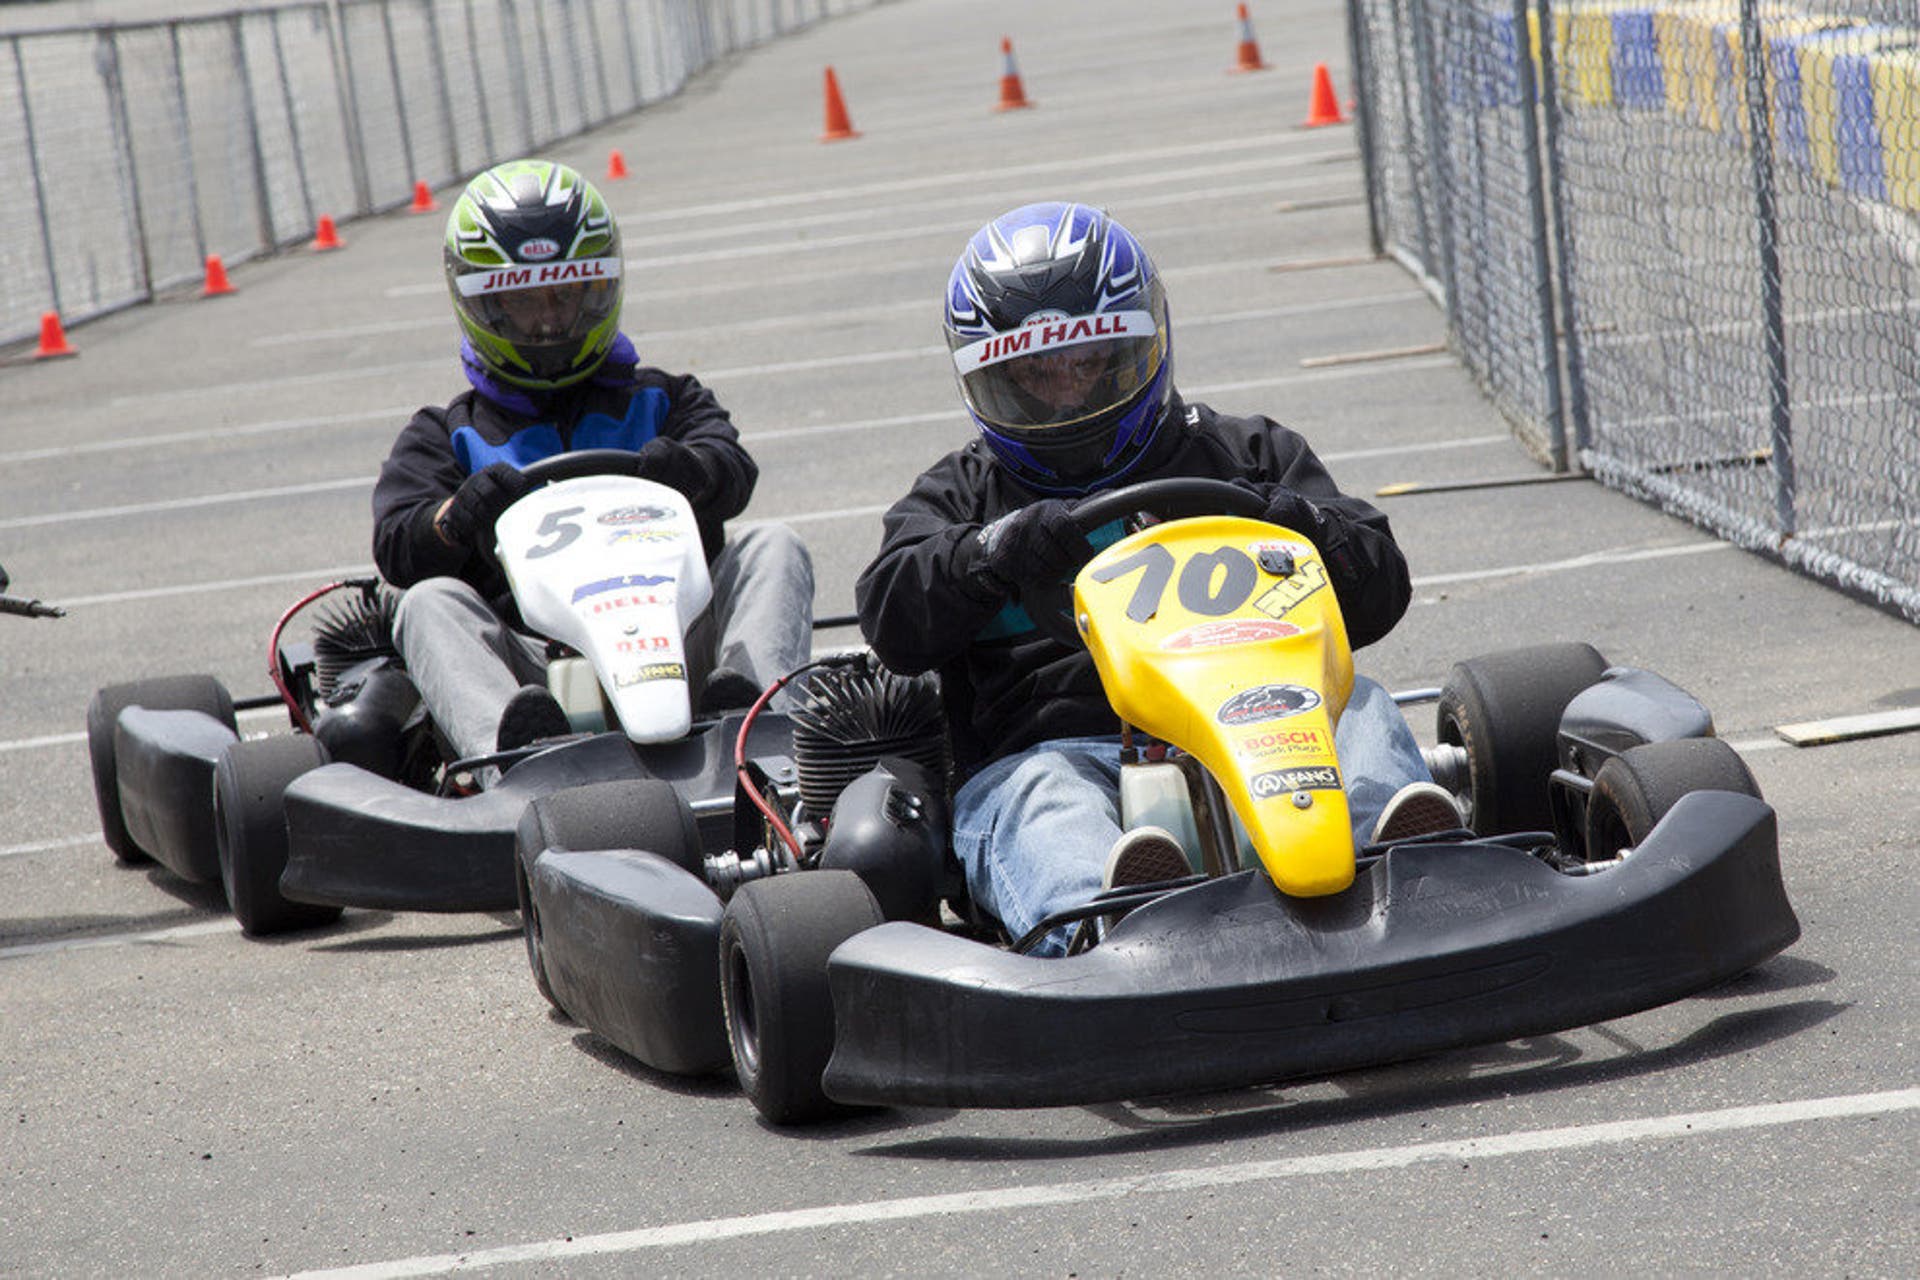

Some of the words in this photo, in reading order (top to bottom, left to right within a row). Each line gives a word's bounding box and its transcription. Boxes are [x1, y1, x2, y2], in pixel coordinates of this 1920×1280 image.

[523, 244, 554, 256] BELL
[482, 269, 532, 290] JIM
[539, 261, 605, 282] HALL
[978, 330, 1033, 363] JIM
[1041, 315, 1128, 345] HALL
[525, 505, 585, 560] 5
[1244, 731, 1319, 751] BOSCH
